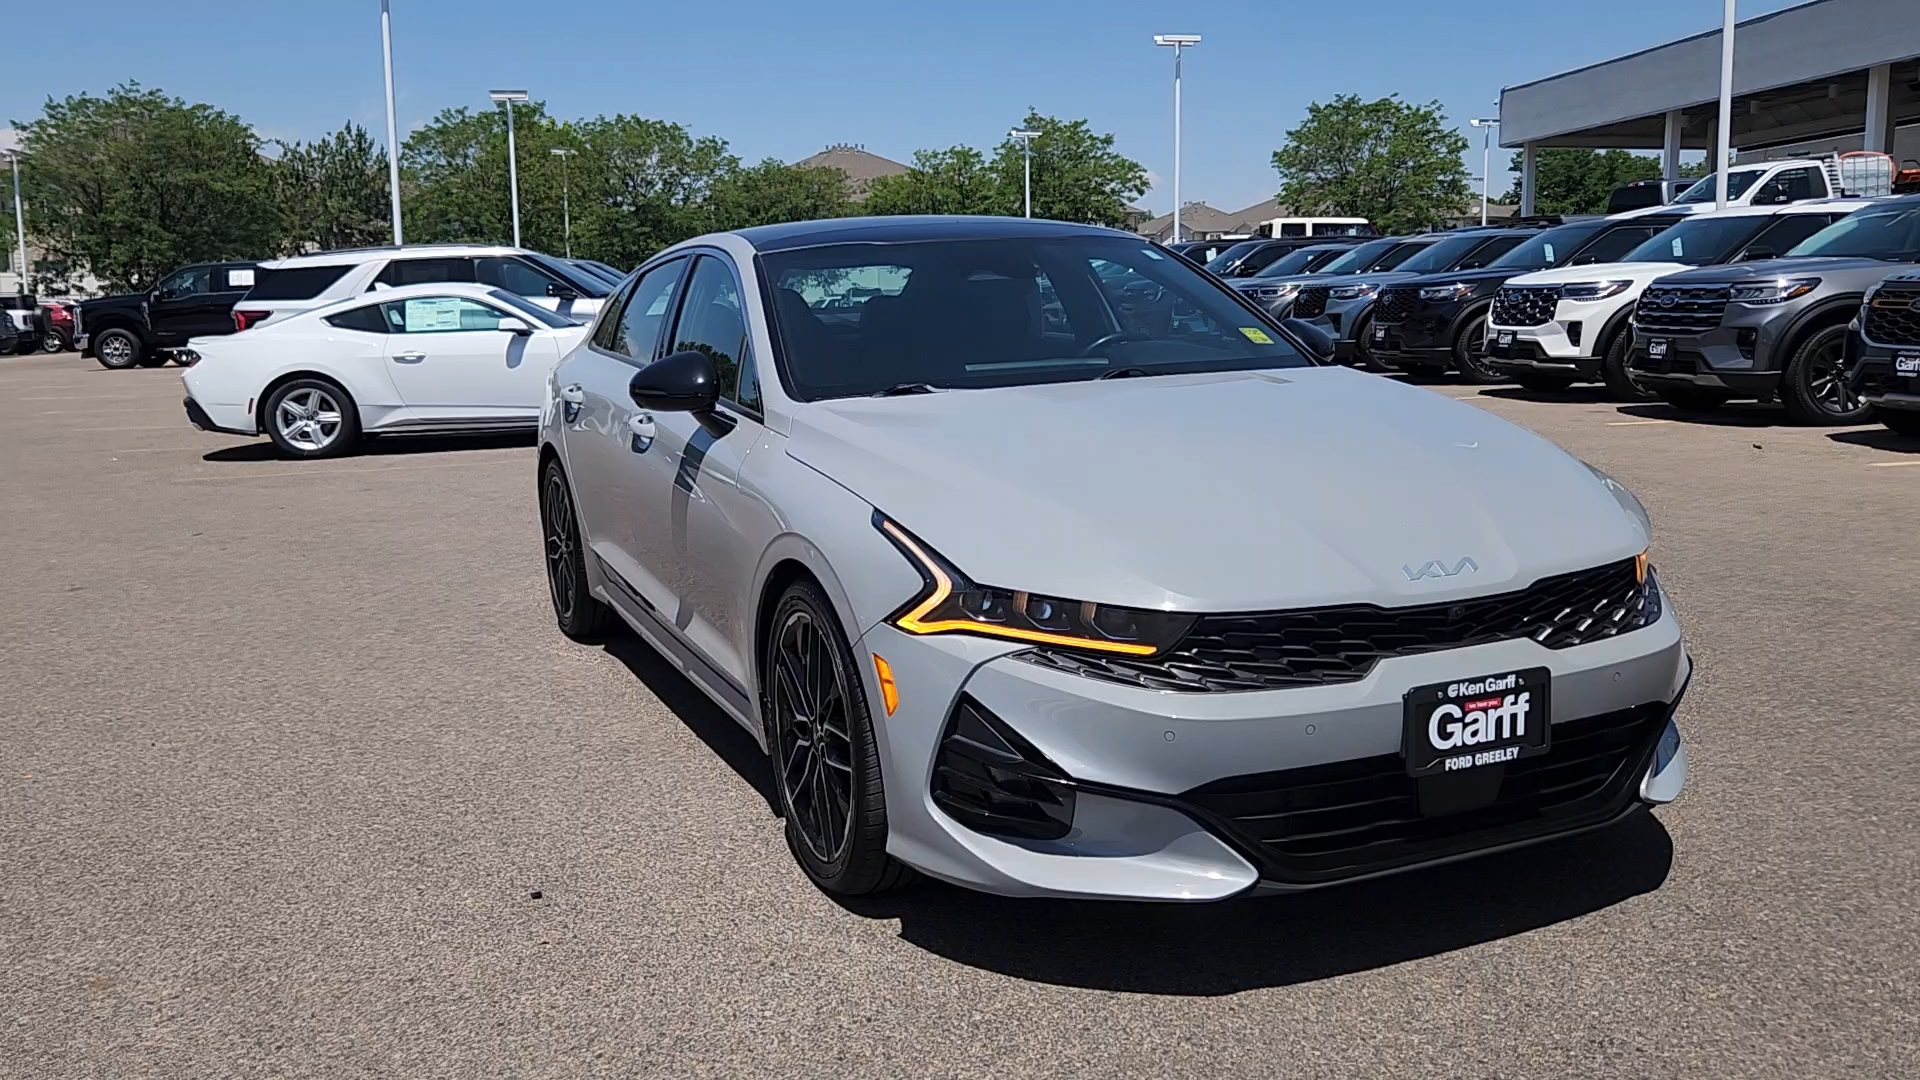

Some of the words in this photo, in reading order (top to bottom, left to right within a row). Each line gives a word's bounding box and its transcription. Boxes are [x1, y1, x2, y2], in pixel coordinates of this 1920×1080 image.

[1896, 357, 1920, 371] Garf
[1459, 682, 1484, 697] Ken
[1485, 674, 1516, 691] Garff
[1428, 692, 1530, 750] Garff
[1444, 755, 1473, 772] FORD
[1474, 746, 1520, 766] GREELEY
